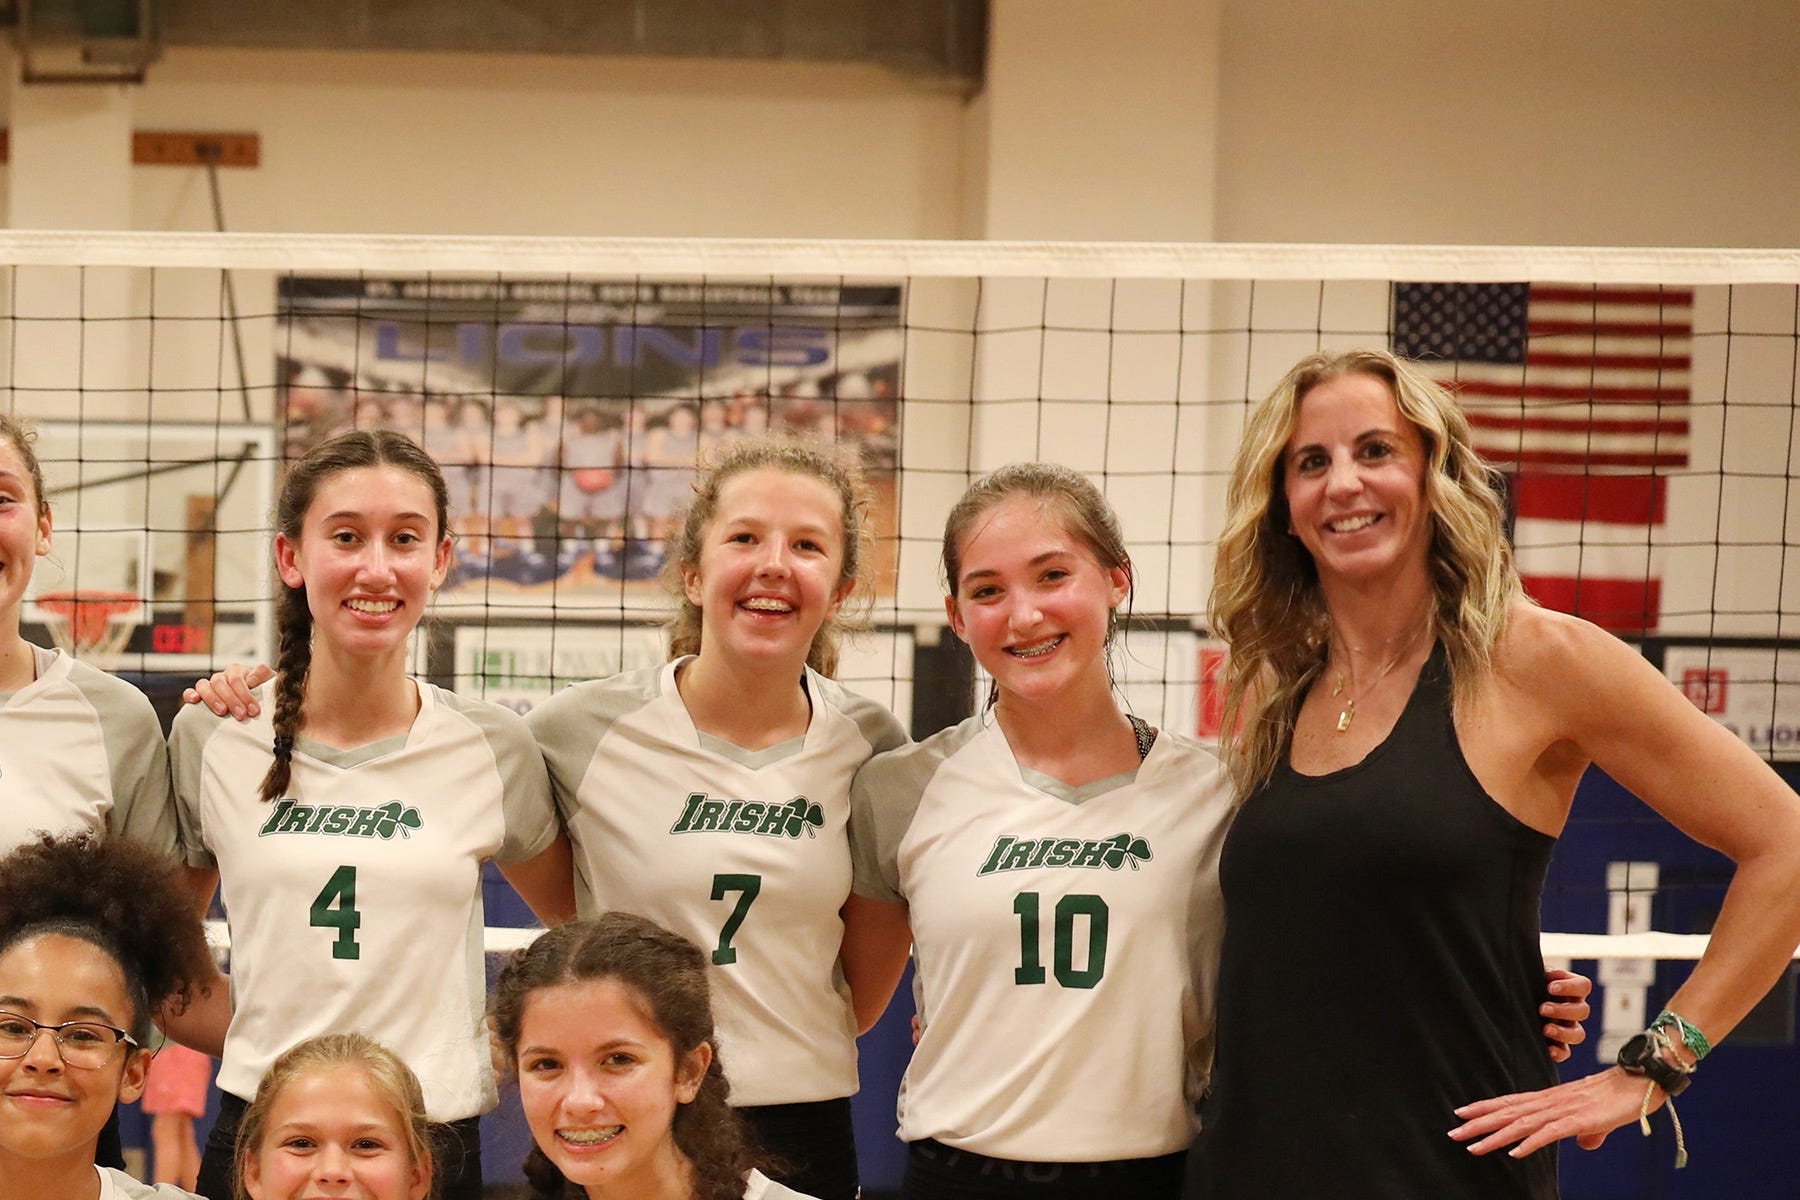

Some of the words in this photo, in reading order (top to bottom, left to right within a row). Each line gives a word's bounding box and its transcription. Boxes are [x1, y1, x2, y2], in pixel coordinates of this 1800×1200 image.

[376, 324, 830, 366] LIONS
[258, 799, 386, 840] IRISH
[670, 792, 792, 838] IRISH
[977, 835, 1110, 877] IRISH
[310, 865, 361, 960] 4
[710, 874, 762, 965] 7
[1013, 892, 1109, 989] 10
